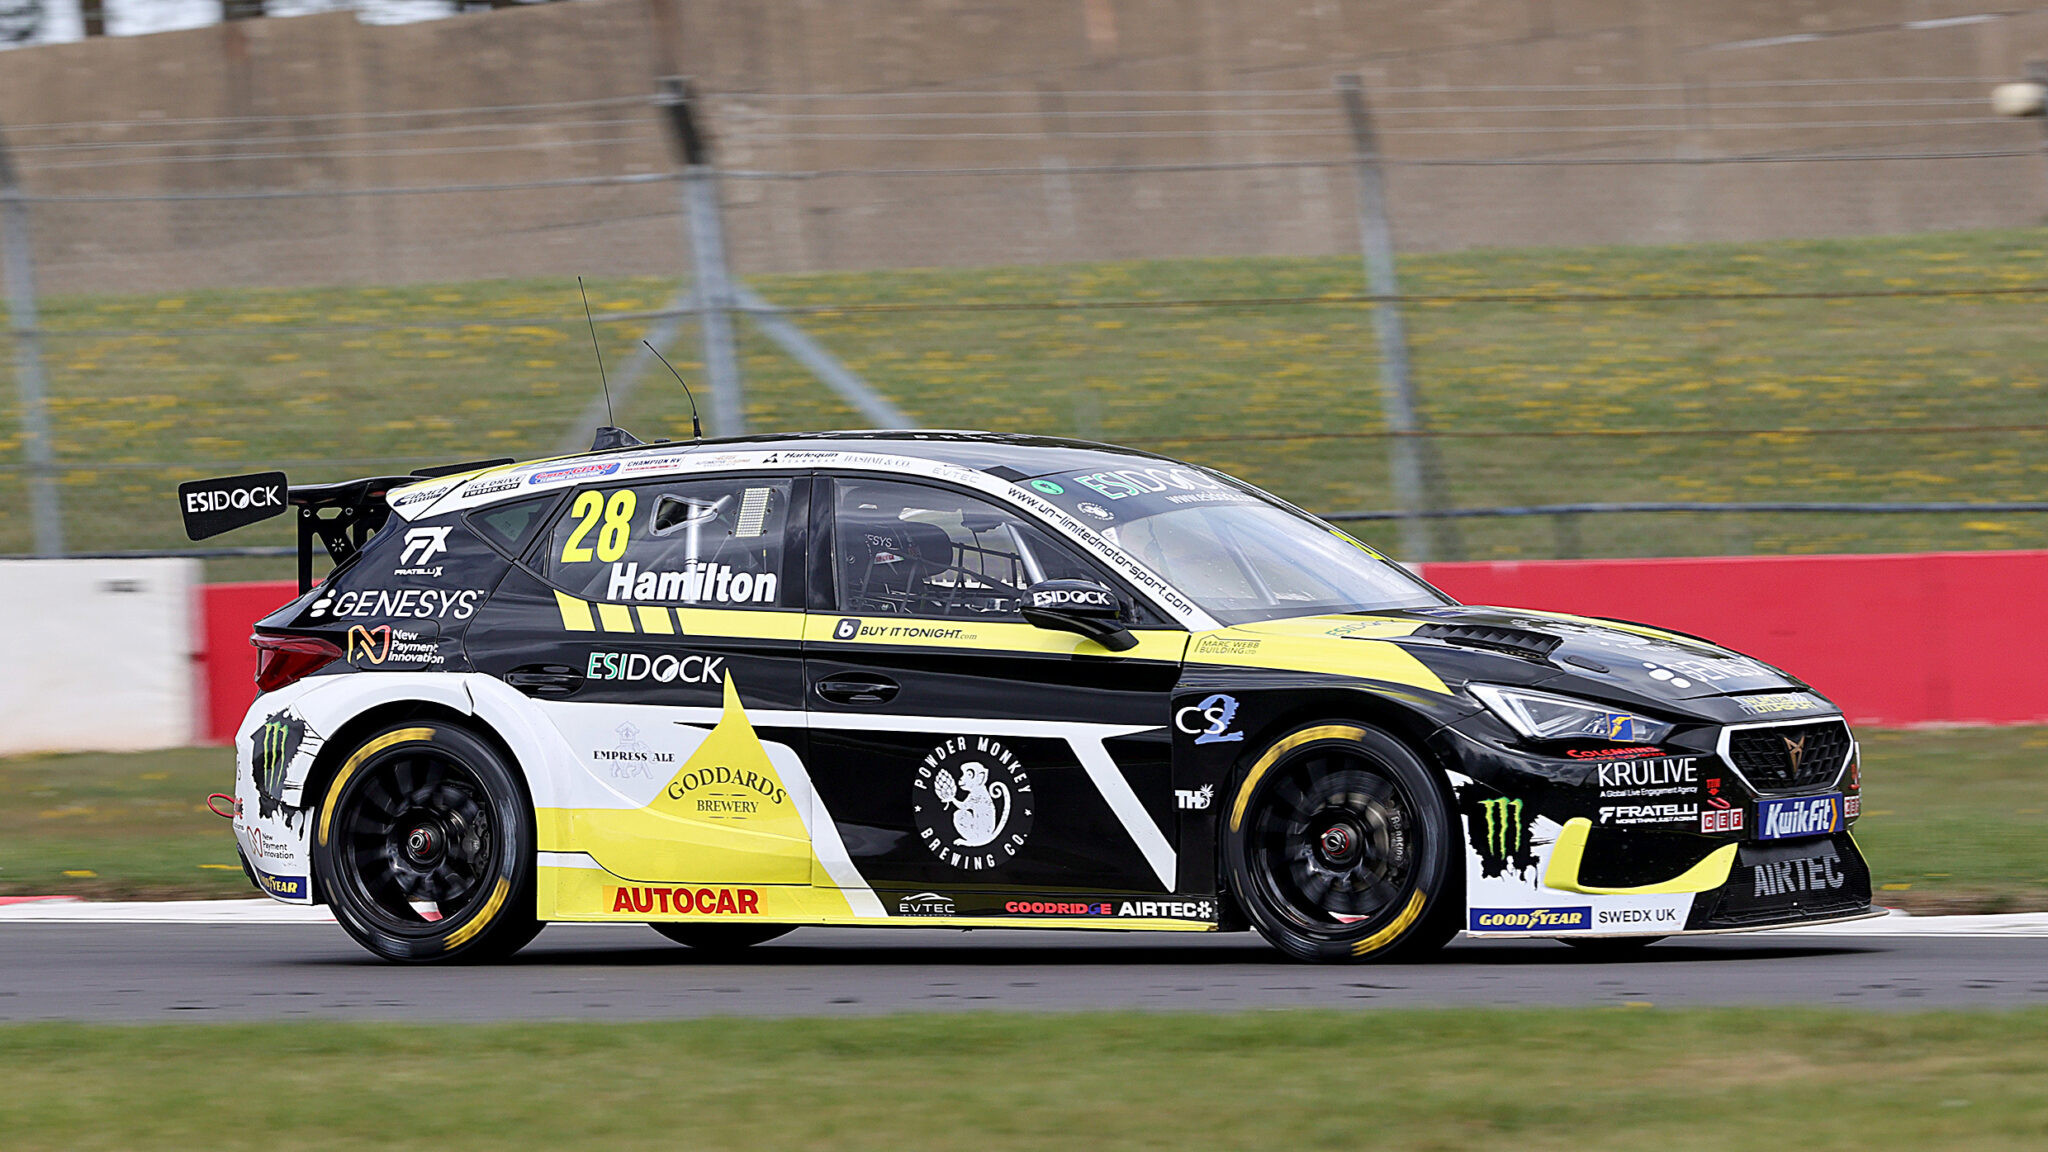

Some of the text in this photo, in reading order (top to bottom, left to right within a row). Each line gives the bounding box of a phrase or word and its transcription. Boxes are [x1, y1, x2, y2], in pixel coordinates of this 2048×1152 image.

[186, 484, 283, 514] ESIDOCK
[560, 488, 637, 563] 28
[1007, 486, 1194, 617] www.un-limitedmotorsport.com
[606, 561, 777, 603] Hamilton
[1032, 590, 1112, 607] ESIDOCK
[391, 629, 419, 641] New
[861, 626, 886, 637] BUY
[390, 641, 440, 654] Payment
[1200, 646, 1244, 655] BUILDING
[1202, 640, 1260, 649] MARC WEBB
[387, 652, 445, 665] Innovation
[586, 652, 725, 684] ESIDOCK
[593, 750, 676, 763] EMPRESS ALE
[913, 736, 967, 790] POWDER
[977, 736, 1032, 794] MONKEY
[1597, 757, 1698, 787] KRULIVE
[667, 766, 787, 805] GODDARDS
[696, 799, 760, 813] BREWERY
[1616, 803, 1698, 818] FRATELLI
[1704, 812, 1741, 830] CEF
[262, 832, 274, 841] New
[1003, 832, 1028, 857] CO.
[262, 840, 288, 852] Payment
[920, 826, 996, 871] BREWING
[263, 850, 295, 860] Innovation
[1752, 855, 1845, 898] AIRTEC
[612, 886, 760, 914] AUTOCAR
[1005, 901, 1112, 915] GOODRIDGE
[899, 903, 956, 914] EVTEC
[1117, 901, 1198, 917] AIRTEC
[1598, 908, 1677, 924] SWEDX UK
[1478, 909, 1583, 929] GOODYEAR
